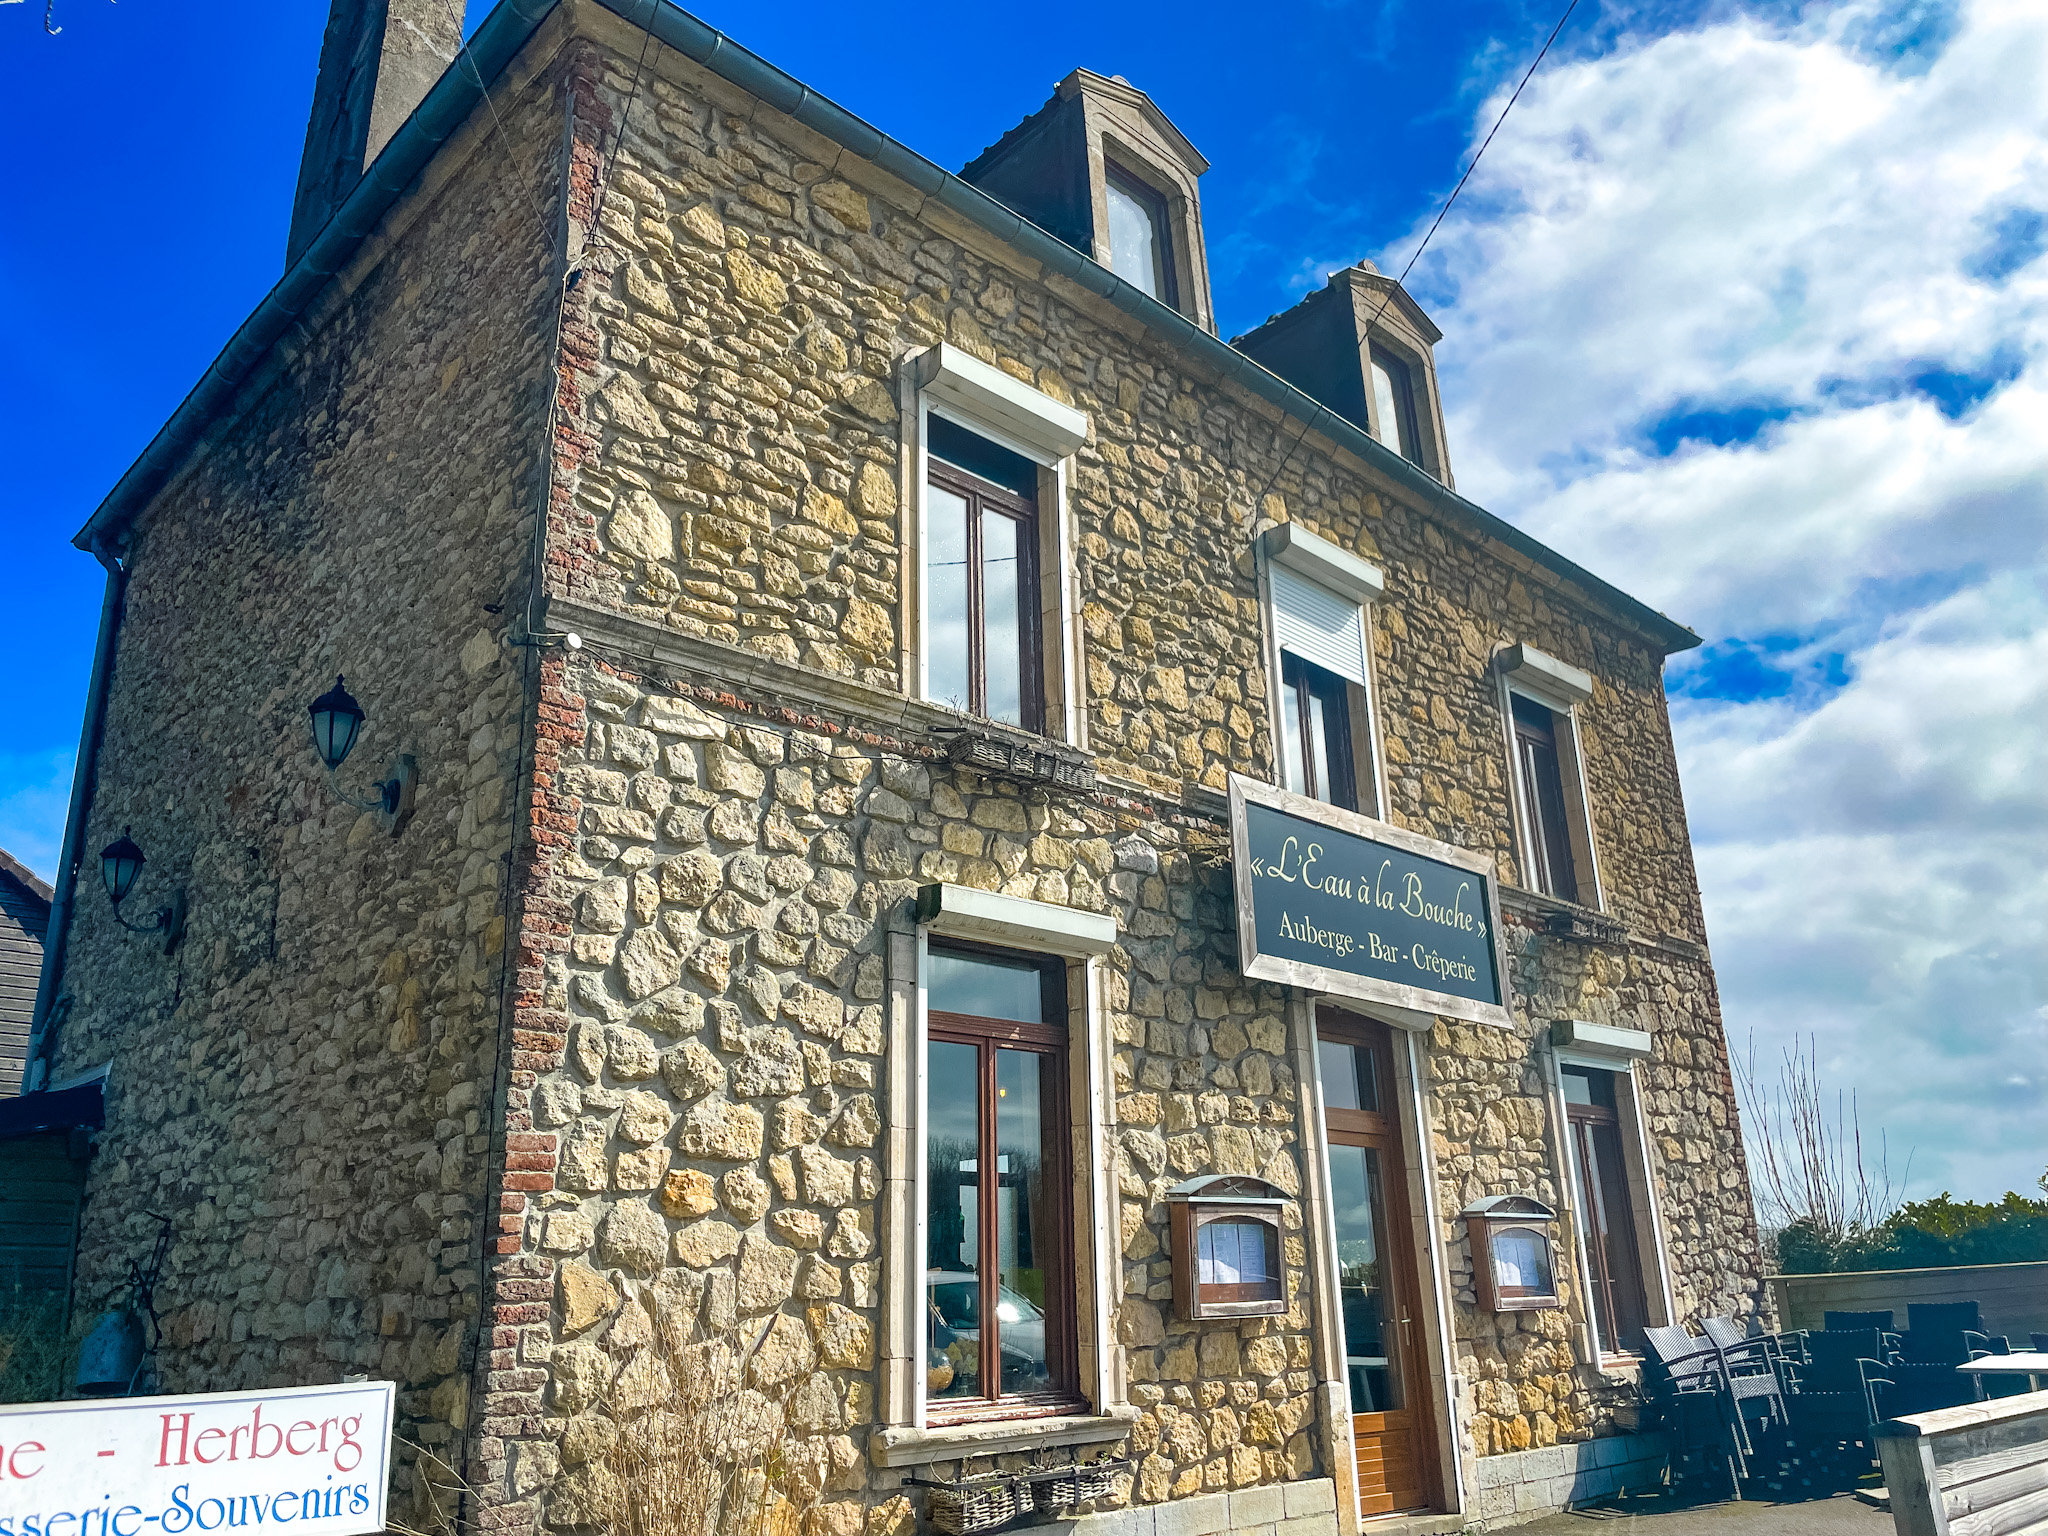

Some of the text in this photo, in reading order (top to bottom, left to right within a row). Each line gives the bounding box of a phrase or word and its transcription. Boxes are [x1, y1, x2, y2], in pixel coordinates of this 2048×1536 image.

[1358, 876, 1371, 905] à
[1375, 859, 1395, 911] la
[1279, 911, 1355, 957] Auberge
[1368, 932, 1399, 964] Bar
[1412, 943, 1477, 983] Crêperie
[154, 1403, 363, 1472] Herberg
